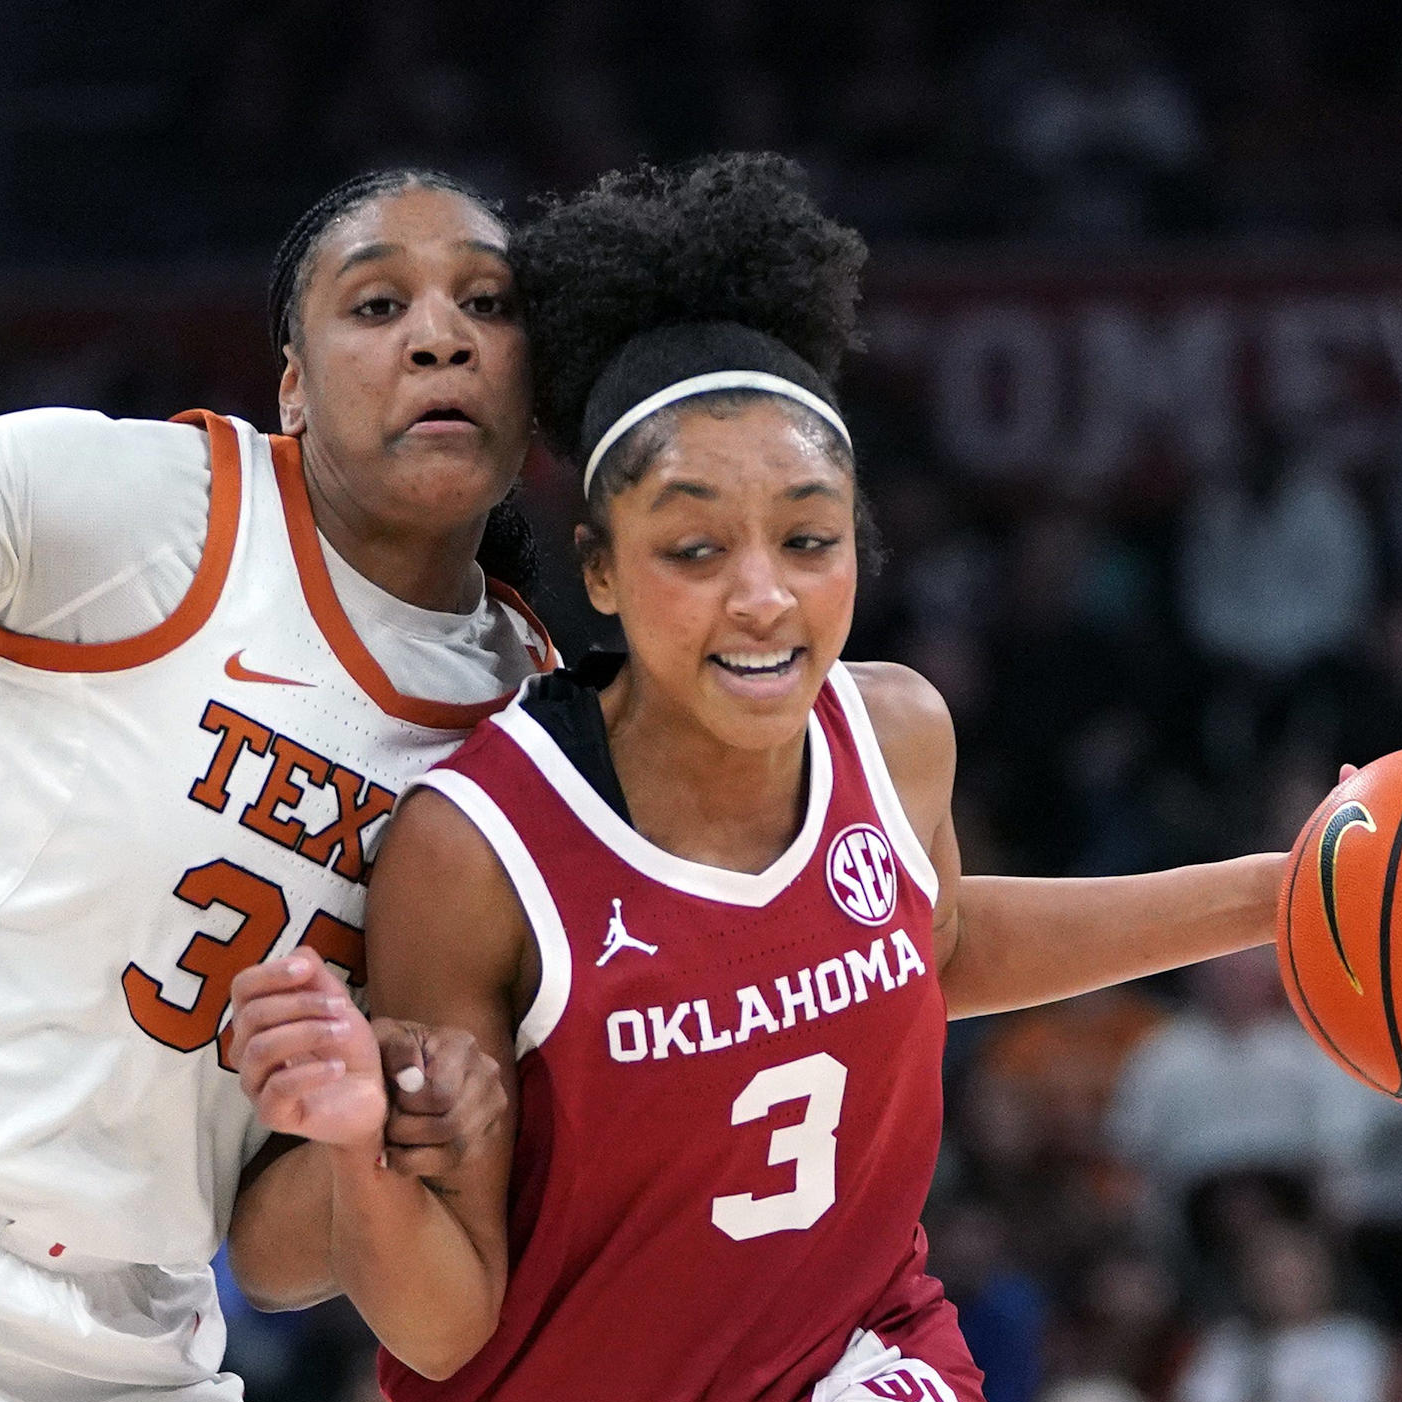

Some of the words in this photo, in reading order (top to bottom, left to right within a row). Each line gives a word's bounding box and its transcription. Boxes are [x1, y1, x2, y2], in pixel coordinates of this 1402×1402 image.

[188, 700, 397, 887] TEX
[831, 830, 894, 918] SEC
[606, 928, 927, 1063] OKLAHOMA
[710, 1051, 850, 1242] 3
